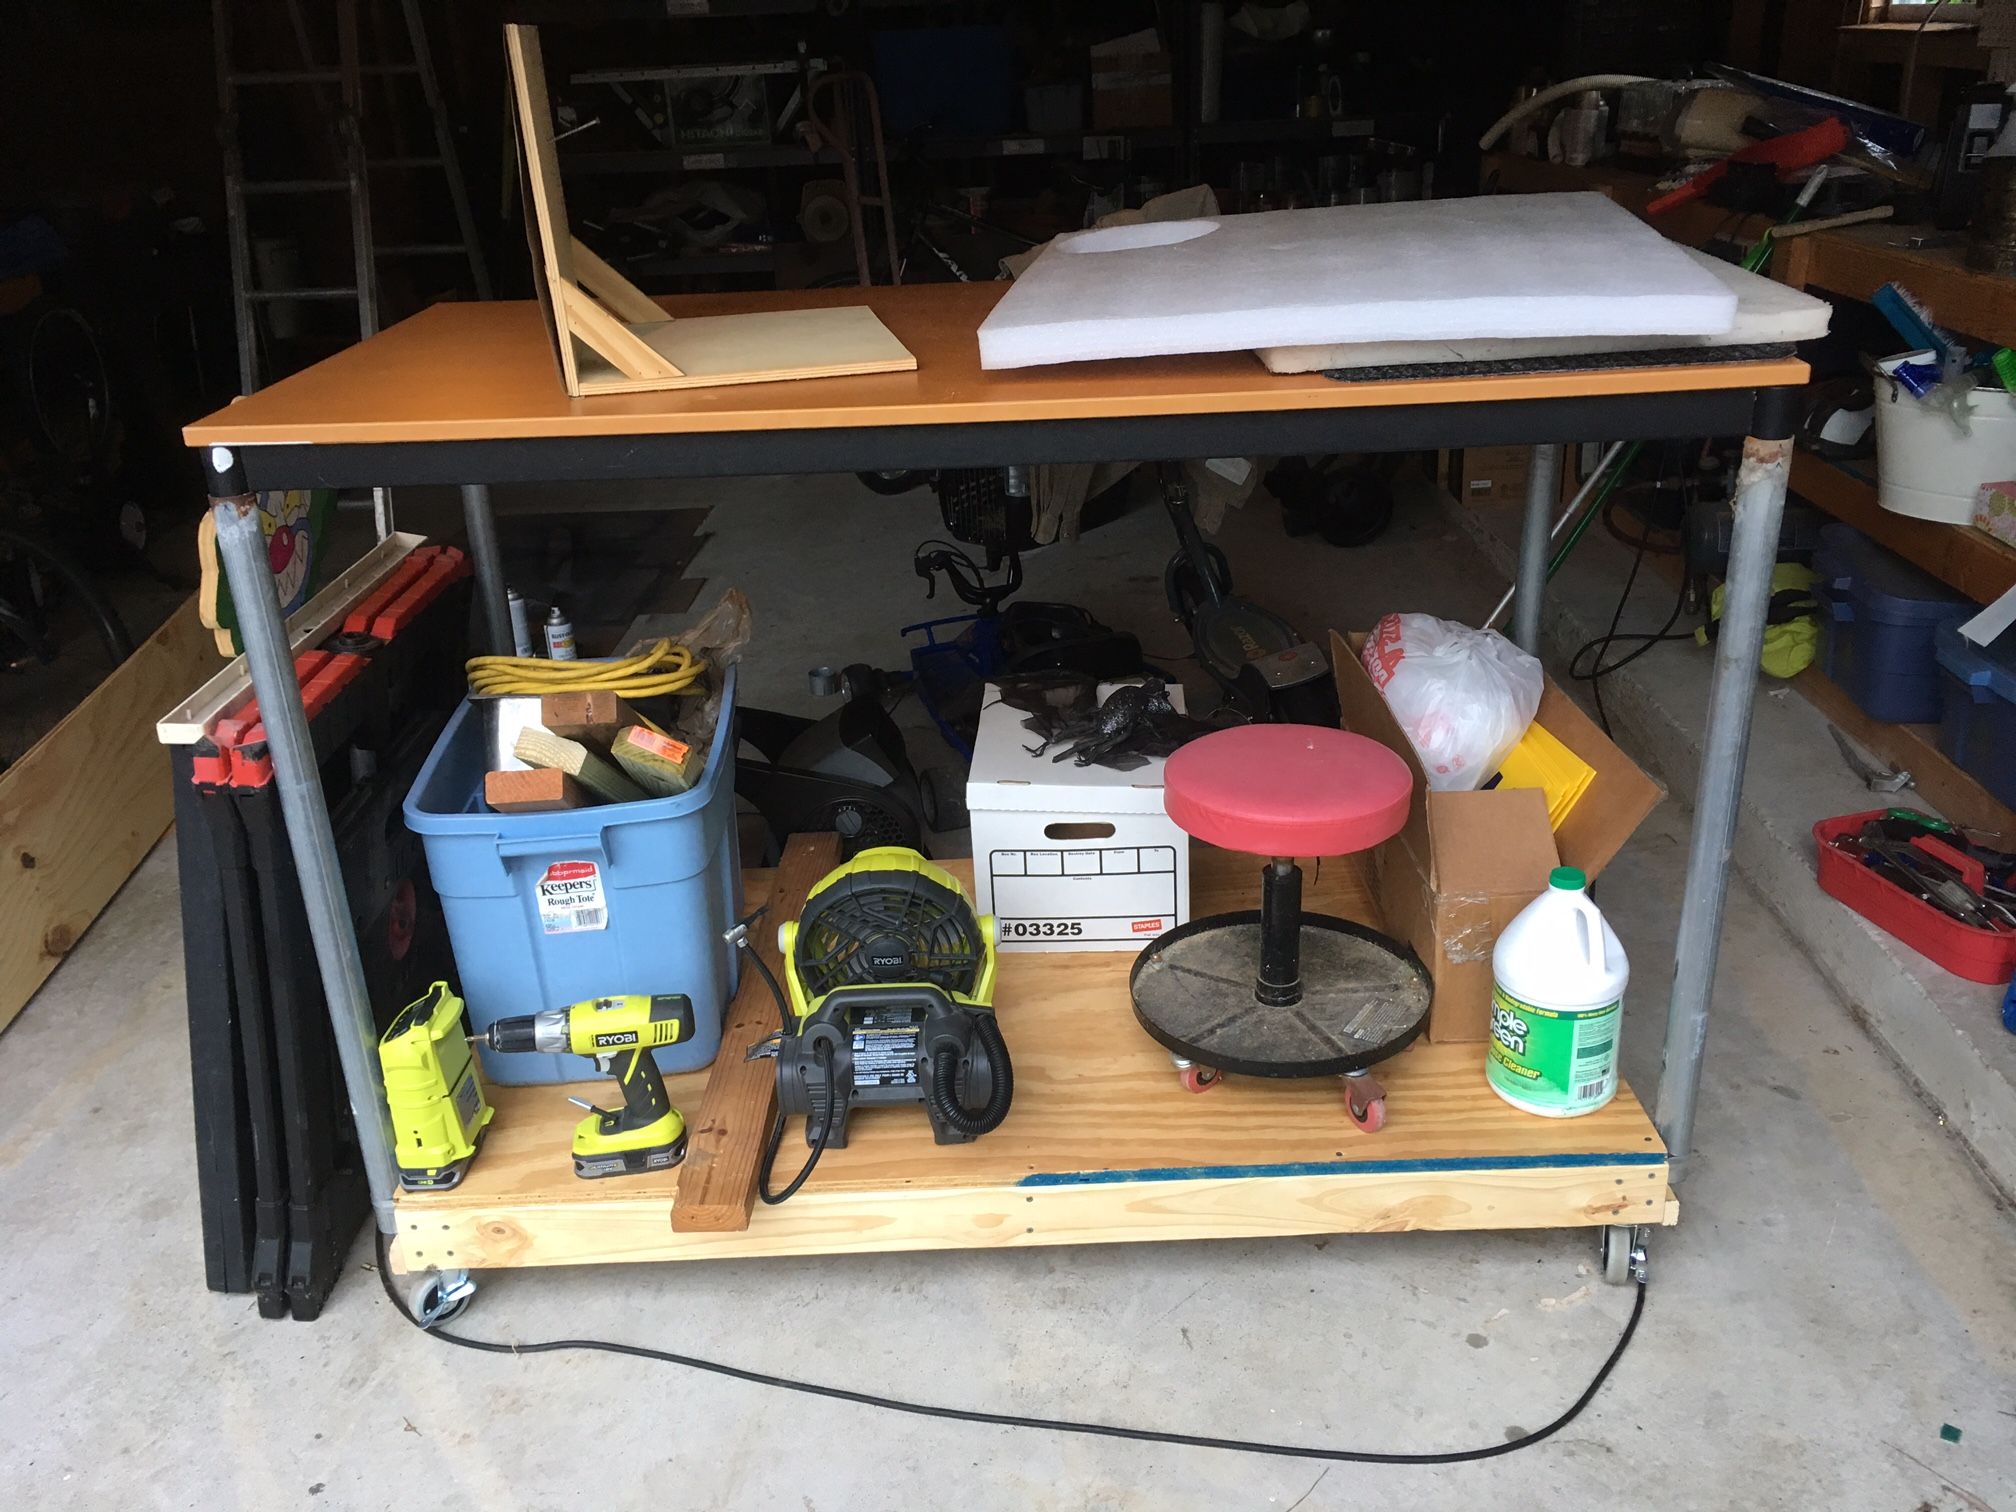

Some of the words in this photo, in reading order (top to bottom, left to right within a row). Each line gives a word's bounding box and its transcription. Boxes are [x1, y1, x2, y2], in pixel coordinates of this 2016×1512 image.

[541, 880, 592, 897] Keepers
[547, 896, 576, 907] Rough
[576, 894, 594, 904] Tote
[1002, 922, 1083, 937] #03325
[1133, 920, 1160, 930] STAPLES
[873, 957, 903, 965] RYOBI
[1492, 999, 1528, 1035] mple
[597, 1032, 637, 1046] RYOBI
[1490, 1018, 1523, 1053] reen
[1503, 1055, 1540, 1079] Cleaner
